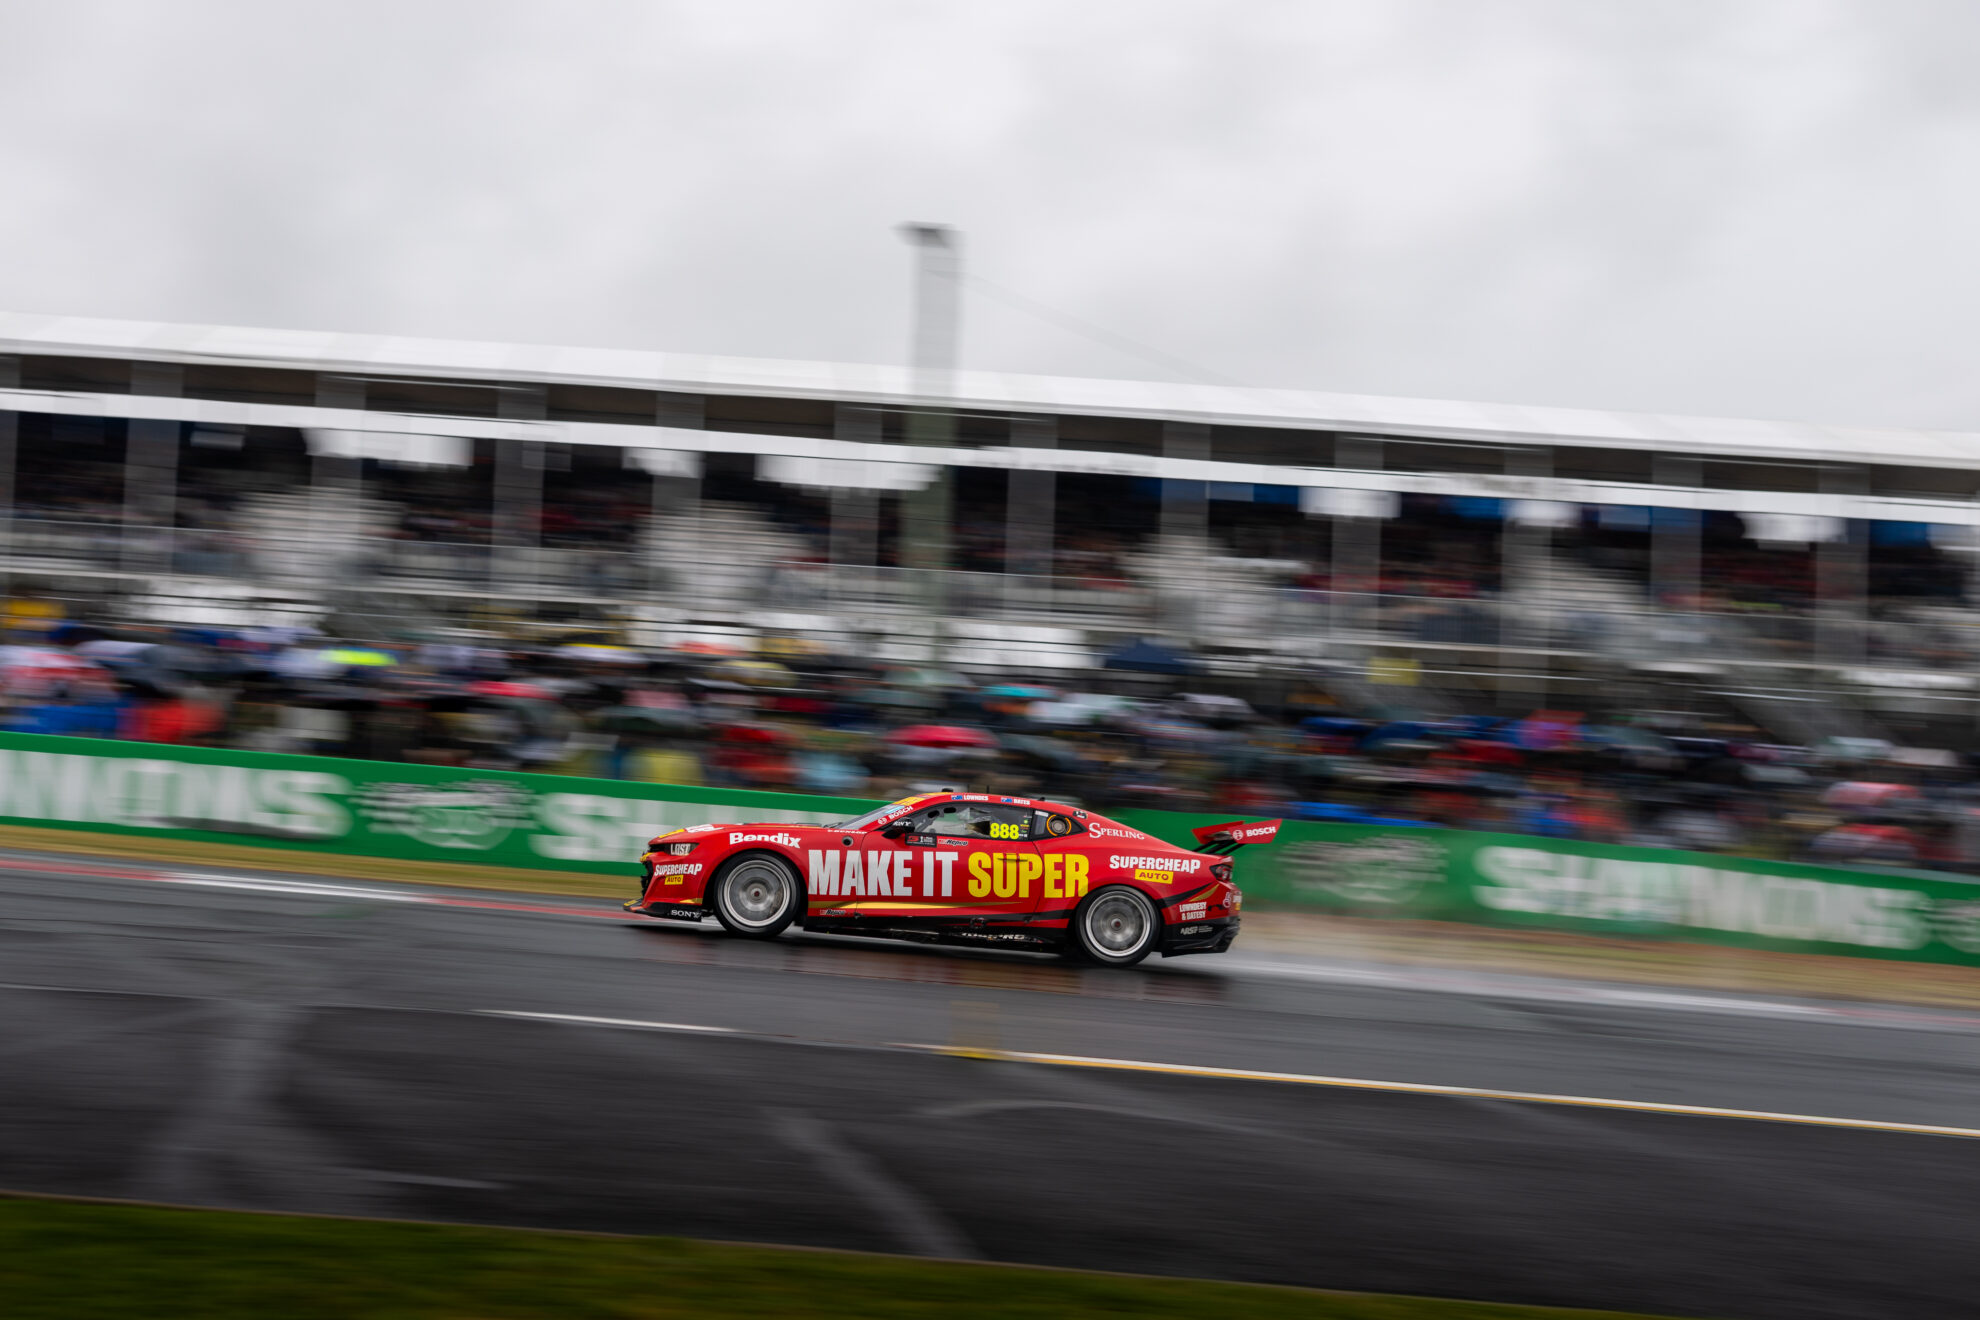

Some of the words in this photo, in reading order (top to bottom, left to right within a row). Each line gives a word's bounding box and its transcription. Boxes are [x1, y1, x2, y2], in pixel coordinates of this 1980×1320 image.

[889, 805, 914, 820] BOSCH
[990, 822, 1019, 839] 888
[1089, 822, 1145, 840] SPERLING
[1246, 826, 1276, 837] BOSCH
[729, 832, 802, 849] Bendix
[654, 863, 703, 877] SUPERCHEAP
[1109, 855, 1201, 874] SUPERCHEAP
[808, 850, 913, 897] MAKE
[923, 851, 958, 897] IT
[968, 851, 1090, 898] SUPER
[1138, 871, 1170, 881] AUTO
[671, 909, 702, 918] SONY
